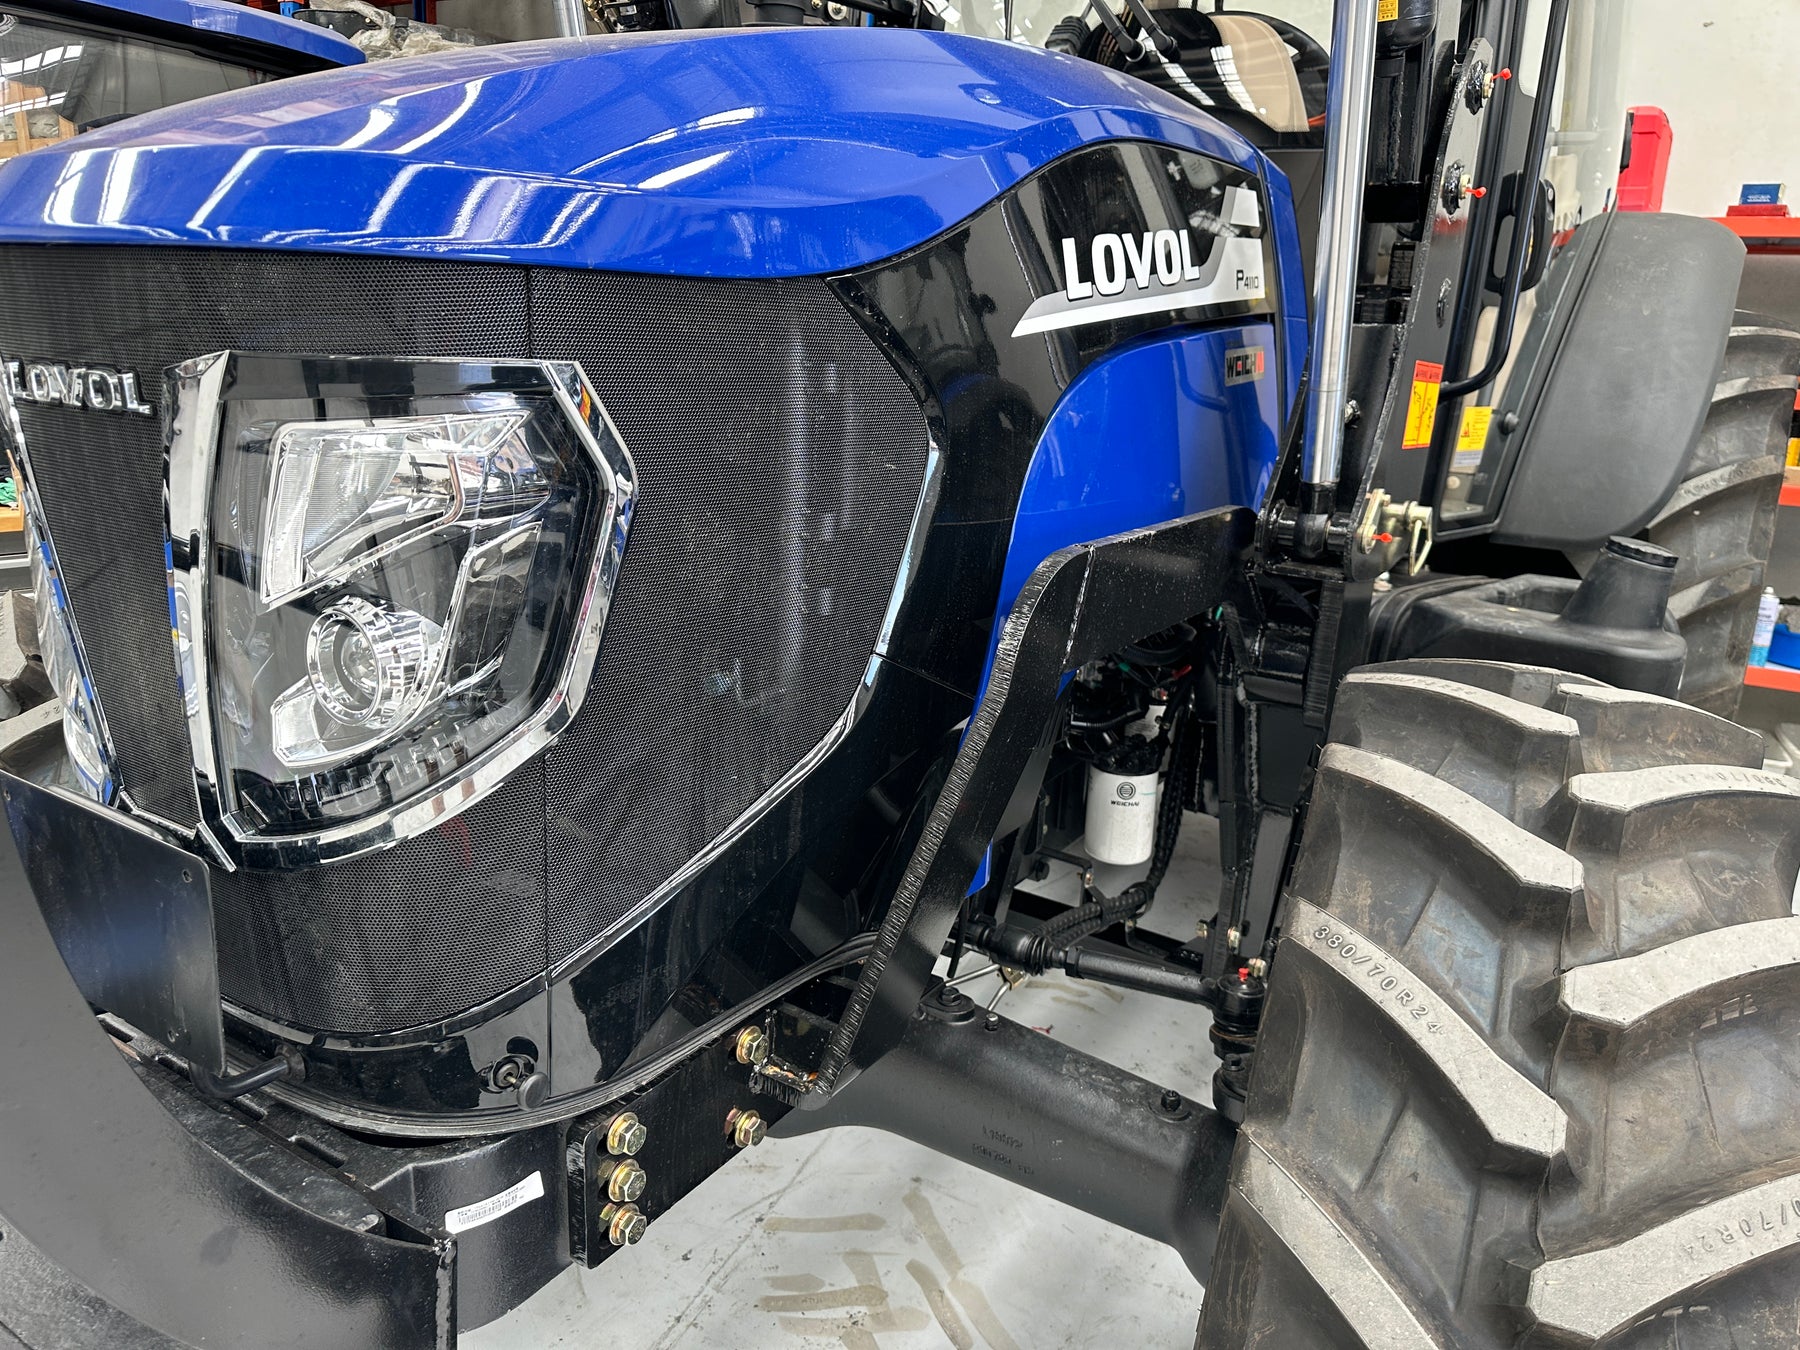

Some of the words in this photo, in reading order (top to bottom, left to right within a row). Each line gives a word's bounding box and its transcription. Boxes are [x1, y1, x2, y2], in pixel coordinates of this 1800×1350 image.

[1062, 229, 1200, 301] LOVOL
[1236, 269, 1259, 290] P4110
[4, 361, 151, 414] LOVOL
[1314, 926, 1441, 1033] 380/70R24
